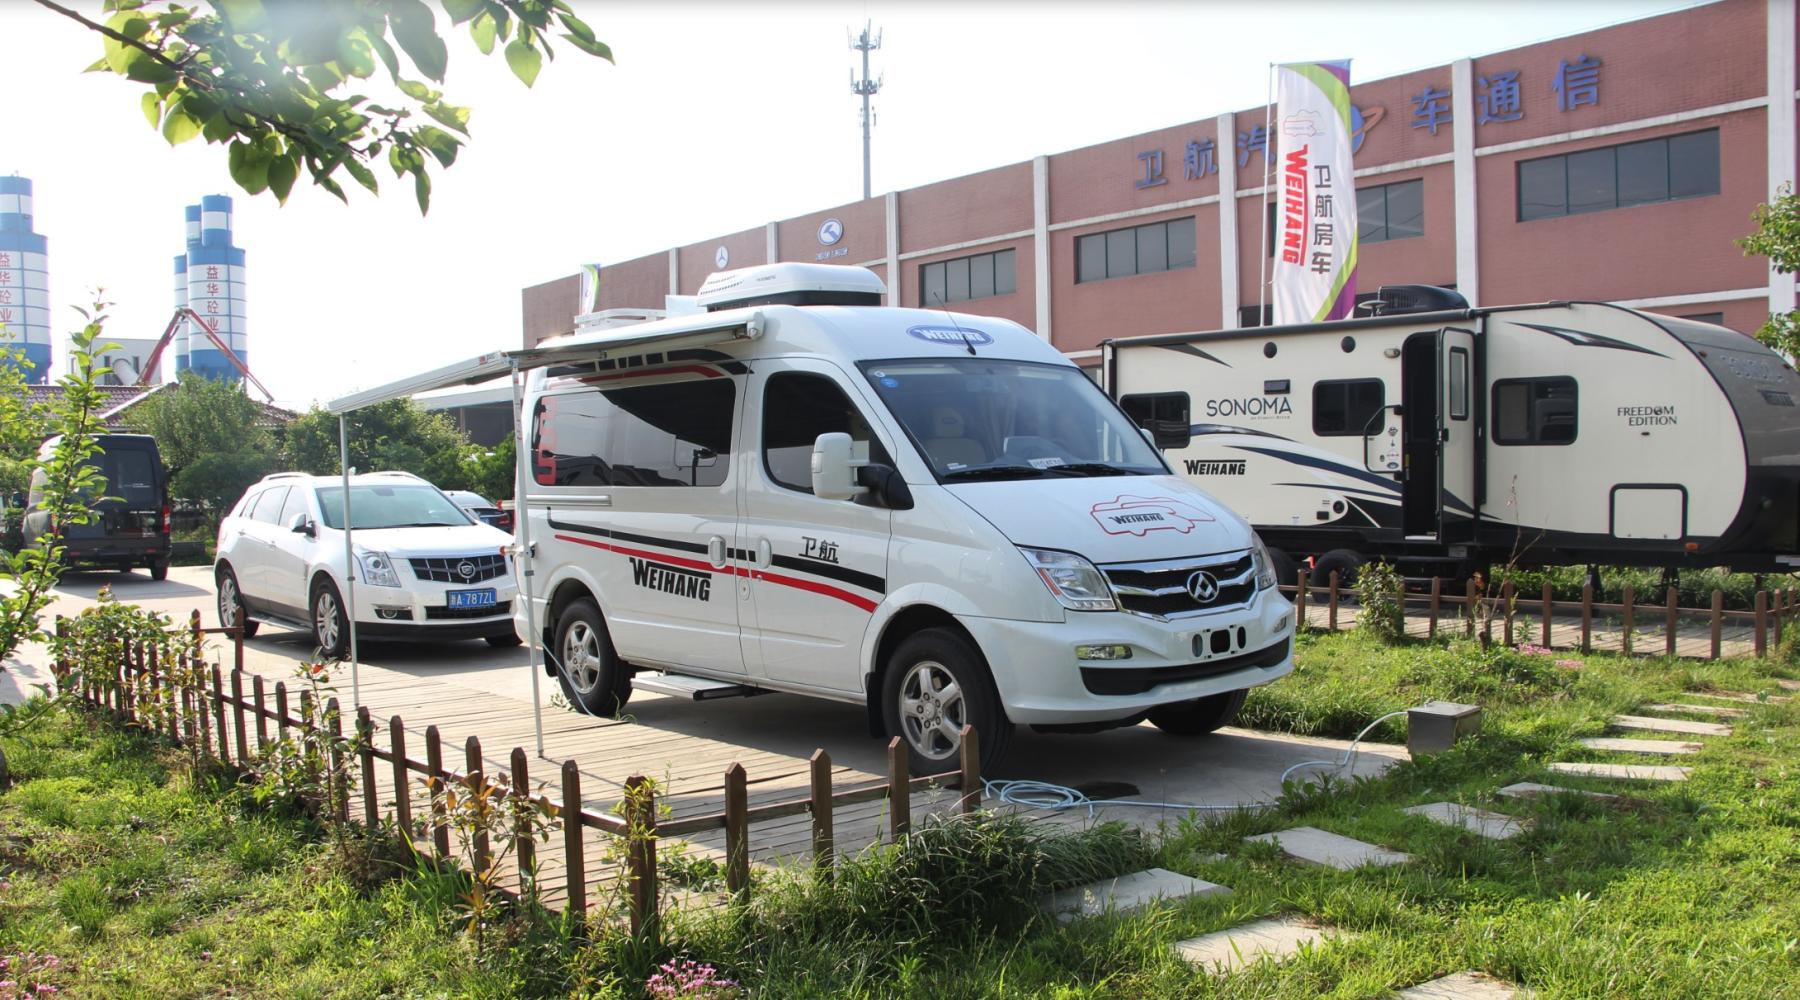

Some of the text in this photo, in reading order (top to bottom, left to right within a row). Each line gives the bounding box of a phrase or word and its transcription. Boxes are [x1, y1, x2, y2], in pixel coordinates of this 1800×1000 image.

[1283, 144, 1308, 266] WEIHANG
[1311, 165, 1334, 274] 卫航房车
[207, 266, 219, 331] 益华砼业
[1206, 397, 1292, 417] SONOMA
[1617, 405, 1674, 416] FREEDOM
[1629, 416, 1677, 426] EDITION
[1183, 459, 1246, 475] WEIHANG
[1108, 513, 1165, 524] WEIHANG
[798, 536, 840, 564] 卫航
[628, 556, 712, 602] WEIHANG
